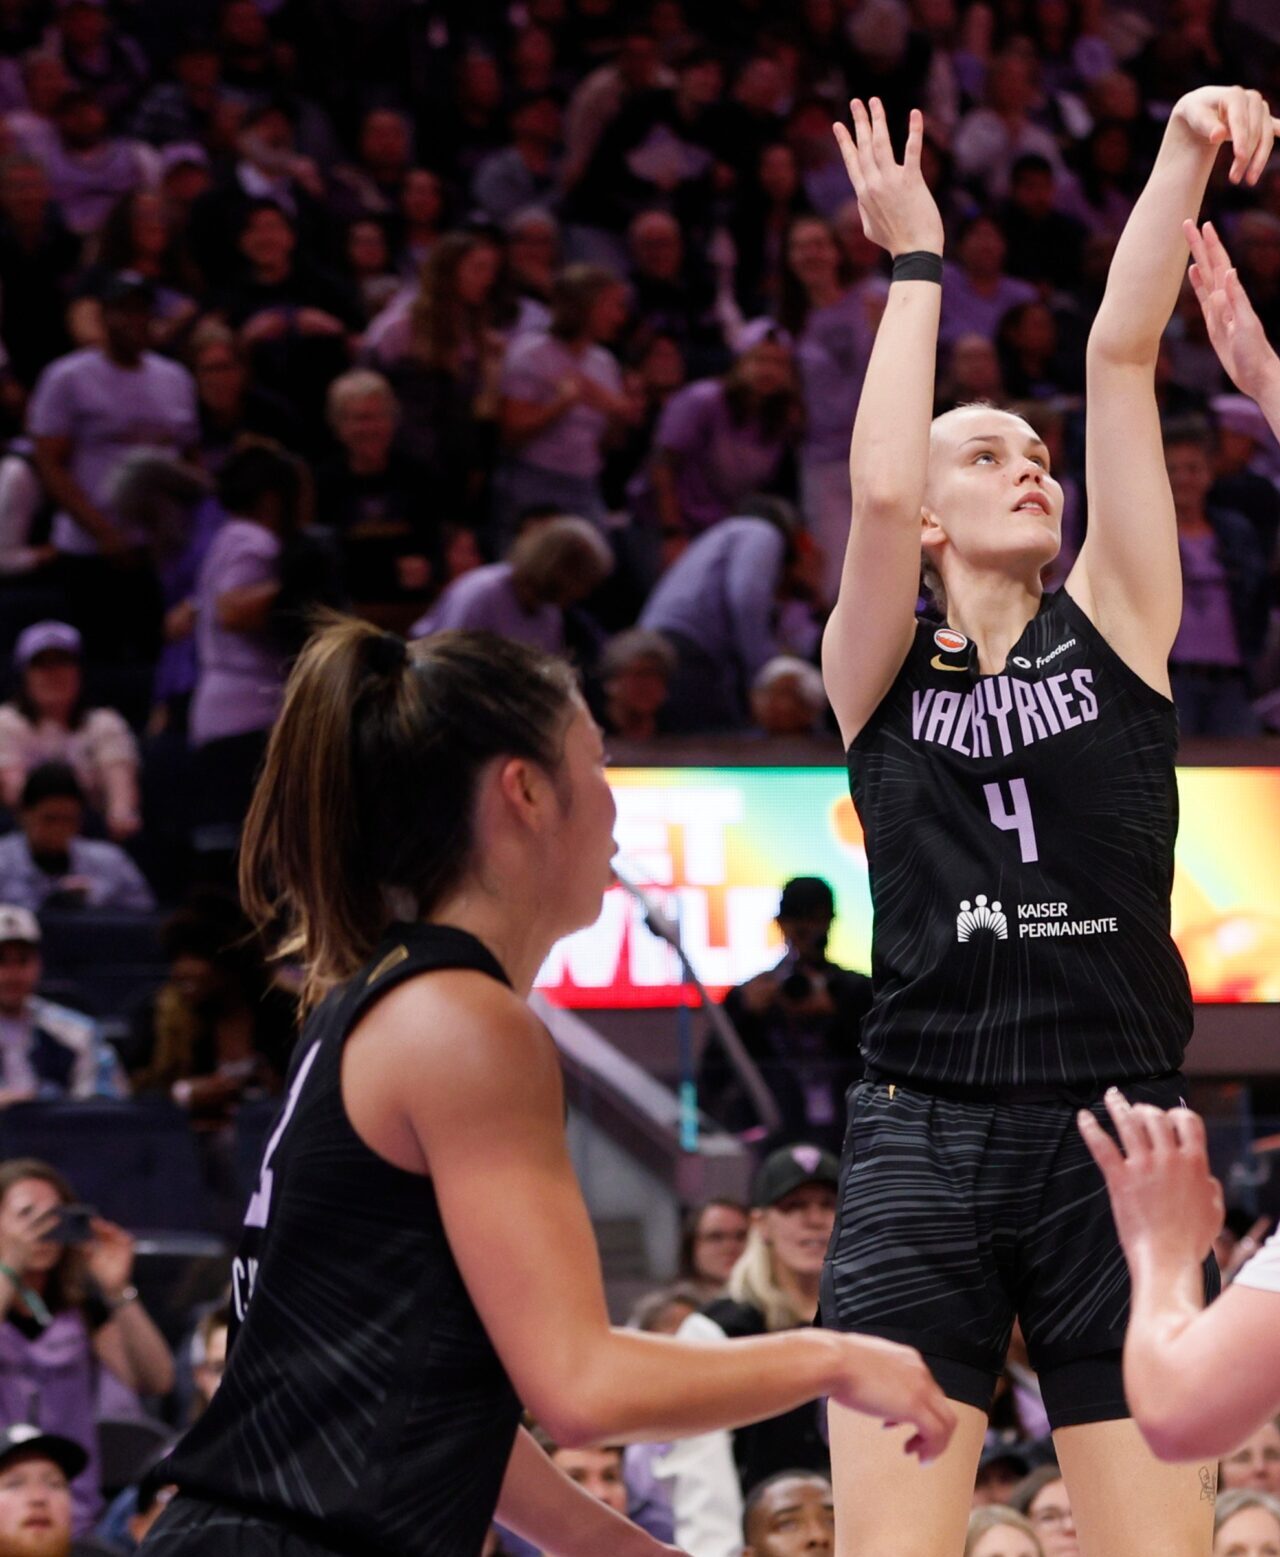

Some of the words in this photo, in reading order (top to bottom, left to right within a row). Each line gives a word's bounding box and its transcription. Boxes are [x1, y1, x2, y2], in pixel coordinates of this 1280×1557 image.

[1036, 638, 1077, 669] freedom
[912, 668, 1099, 758] VALKYRIES
[609, 785, 743, 886] ET
[983, 777, 1039, 863] 4
[1017, 902, 1068, 917] KAISER
[1019, 918, 1118, 938] PERMANENTE
